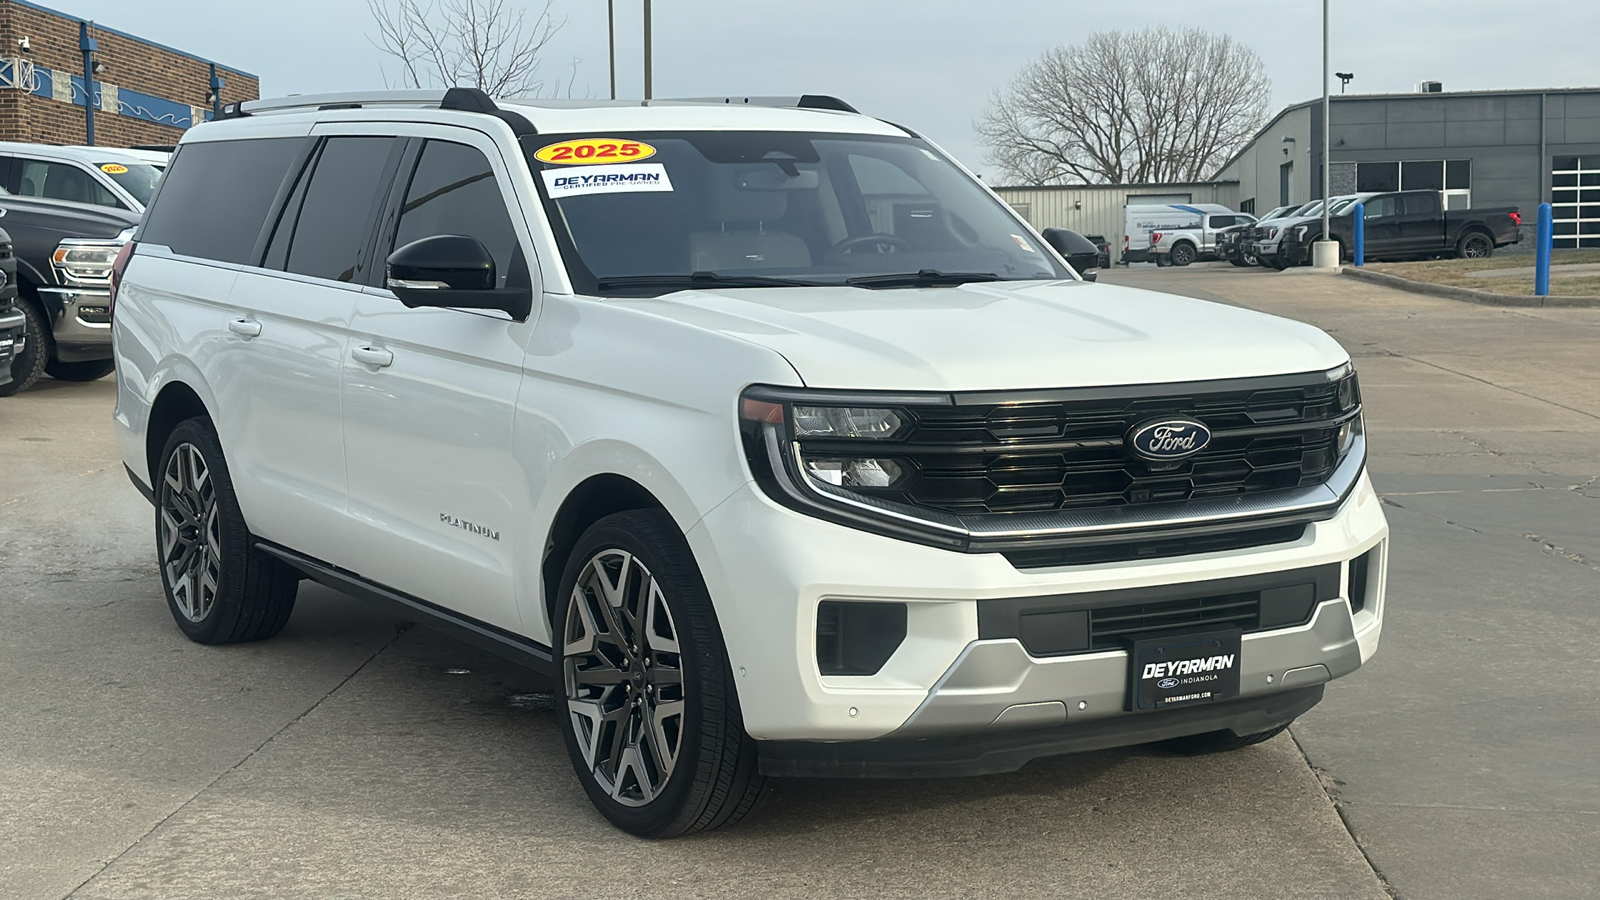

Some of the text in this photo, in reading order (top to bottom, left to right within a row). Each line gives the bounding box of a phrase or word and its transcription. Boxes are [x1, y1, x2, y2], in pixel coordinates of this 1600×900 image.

[551, 143, 641, 161] 2025
[554, 173, 660, 187] DEYARMAN
[1149, 426, 1197, 452] Ford
[440, 513, 500, 541] PLATINUM
[1142, 654, 1235, 680] DEYARMAN
[1180, 674, 1218, 685] INDIANOLA
[1164, 691, 1211, 703] DEYARMANFORD.COM
